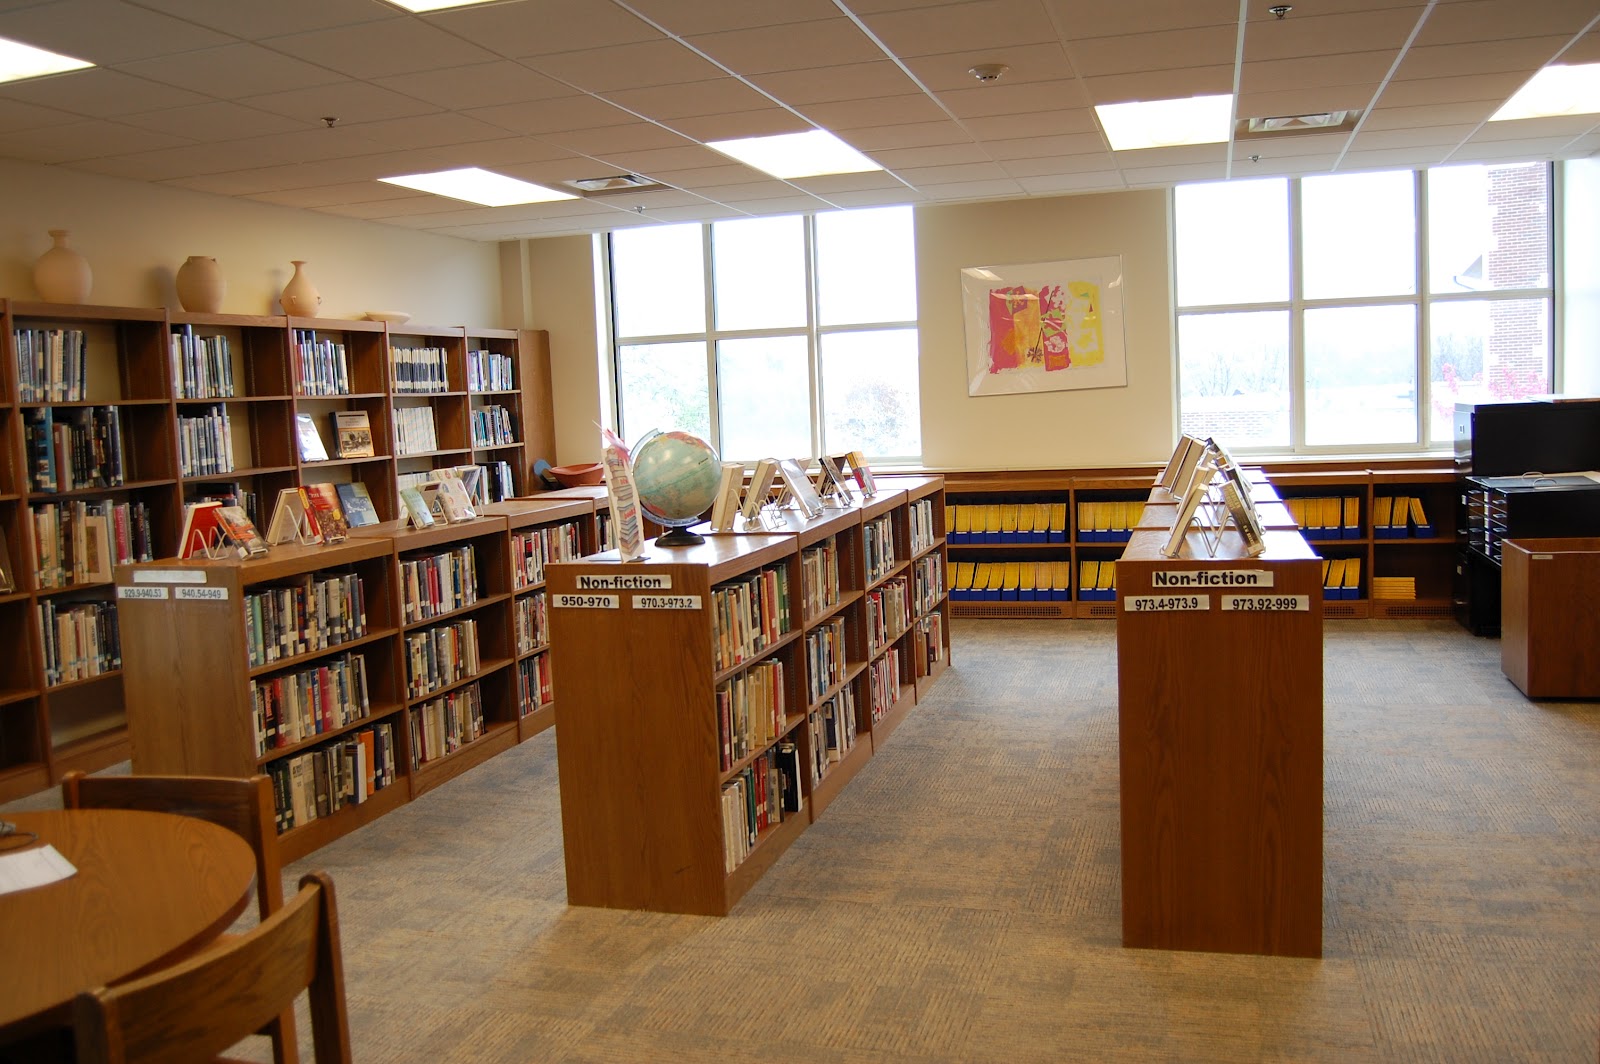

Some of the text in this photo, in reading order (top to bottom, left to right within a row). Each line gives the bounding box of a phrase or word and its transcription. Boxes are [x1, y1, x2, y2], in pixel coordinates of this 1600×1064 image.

[580, 576, 662, 589] Non-fiction
[1155, 571, 1258, 586] Non-fiction
[124, 588, 162, 598] 929.9-940.53
[181, 588, 221, 599] 940.54-949
[561, 595, 611, 608] 950-970
[641, 597, 693, 608] 970.3-973.2
[1135, 597, 1199, 611] 973.4-973.9
[1232, 597, 1298, 611] 973.92-999
